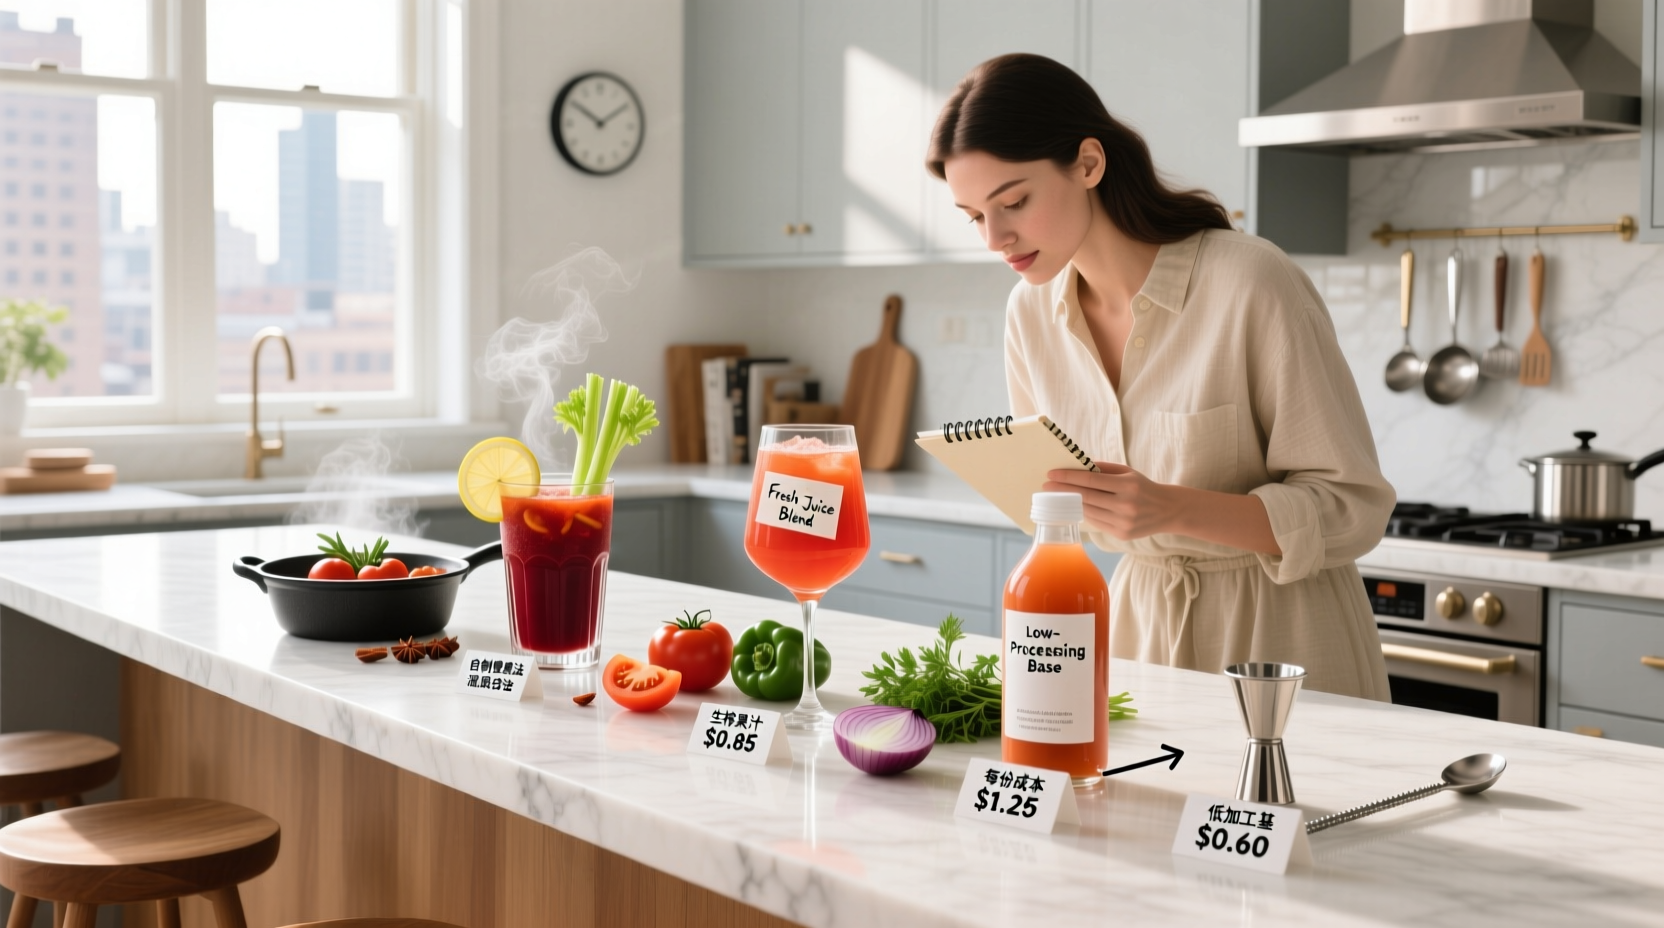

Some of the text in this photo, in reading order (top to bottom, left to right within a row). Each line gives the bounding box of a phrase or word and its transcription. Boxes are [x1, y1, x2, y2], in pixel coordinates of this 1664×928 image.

[768, 483, 835, 515] Fresh Juice
[778, 506, 814, 527] Blend
[1026, 625, 1060, 639] Low-
[1027, 659, 1062, 673] Base
[703, 726, 758, 752] $0.85
[974, 786, 1039, 818] $1.25
[1208, 804, 1275, 831] 低加工基
[1195, 823, 1269, 858] $0.60
